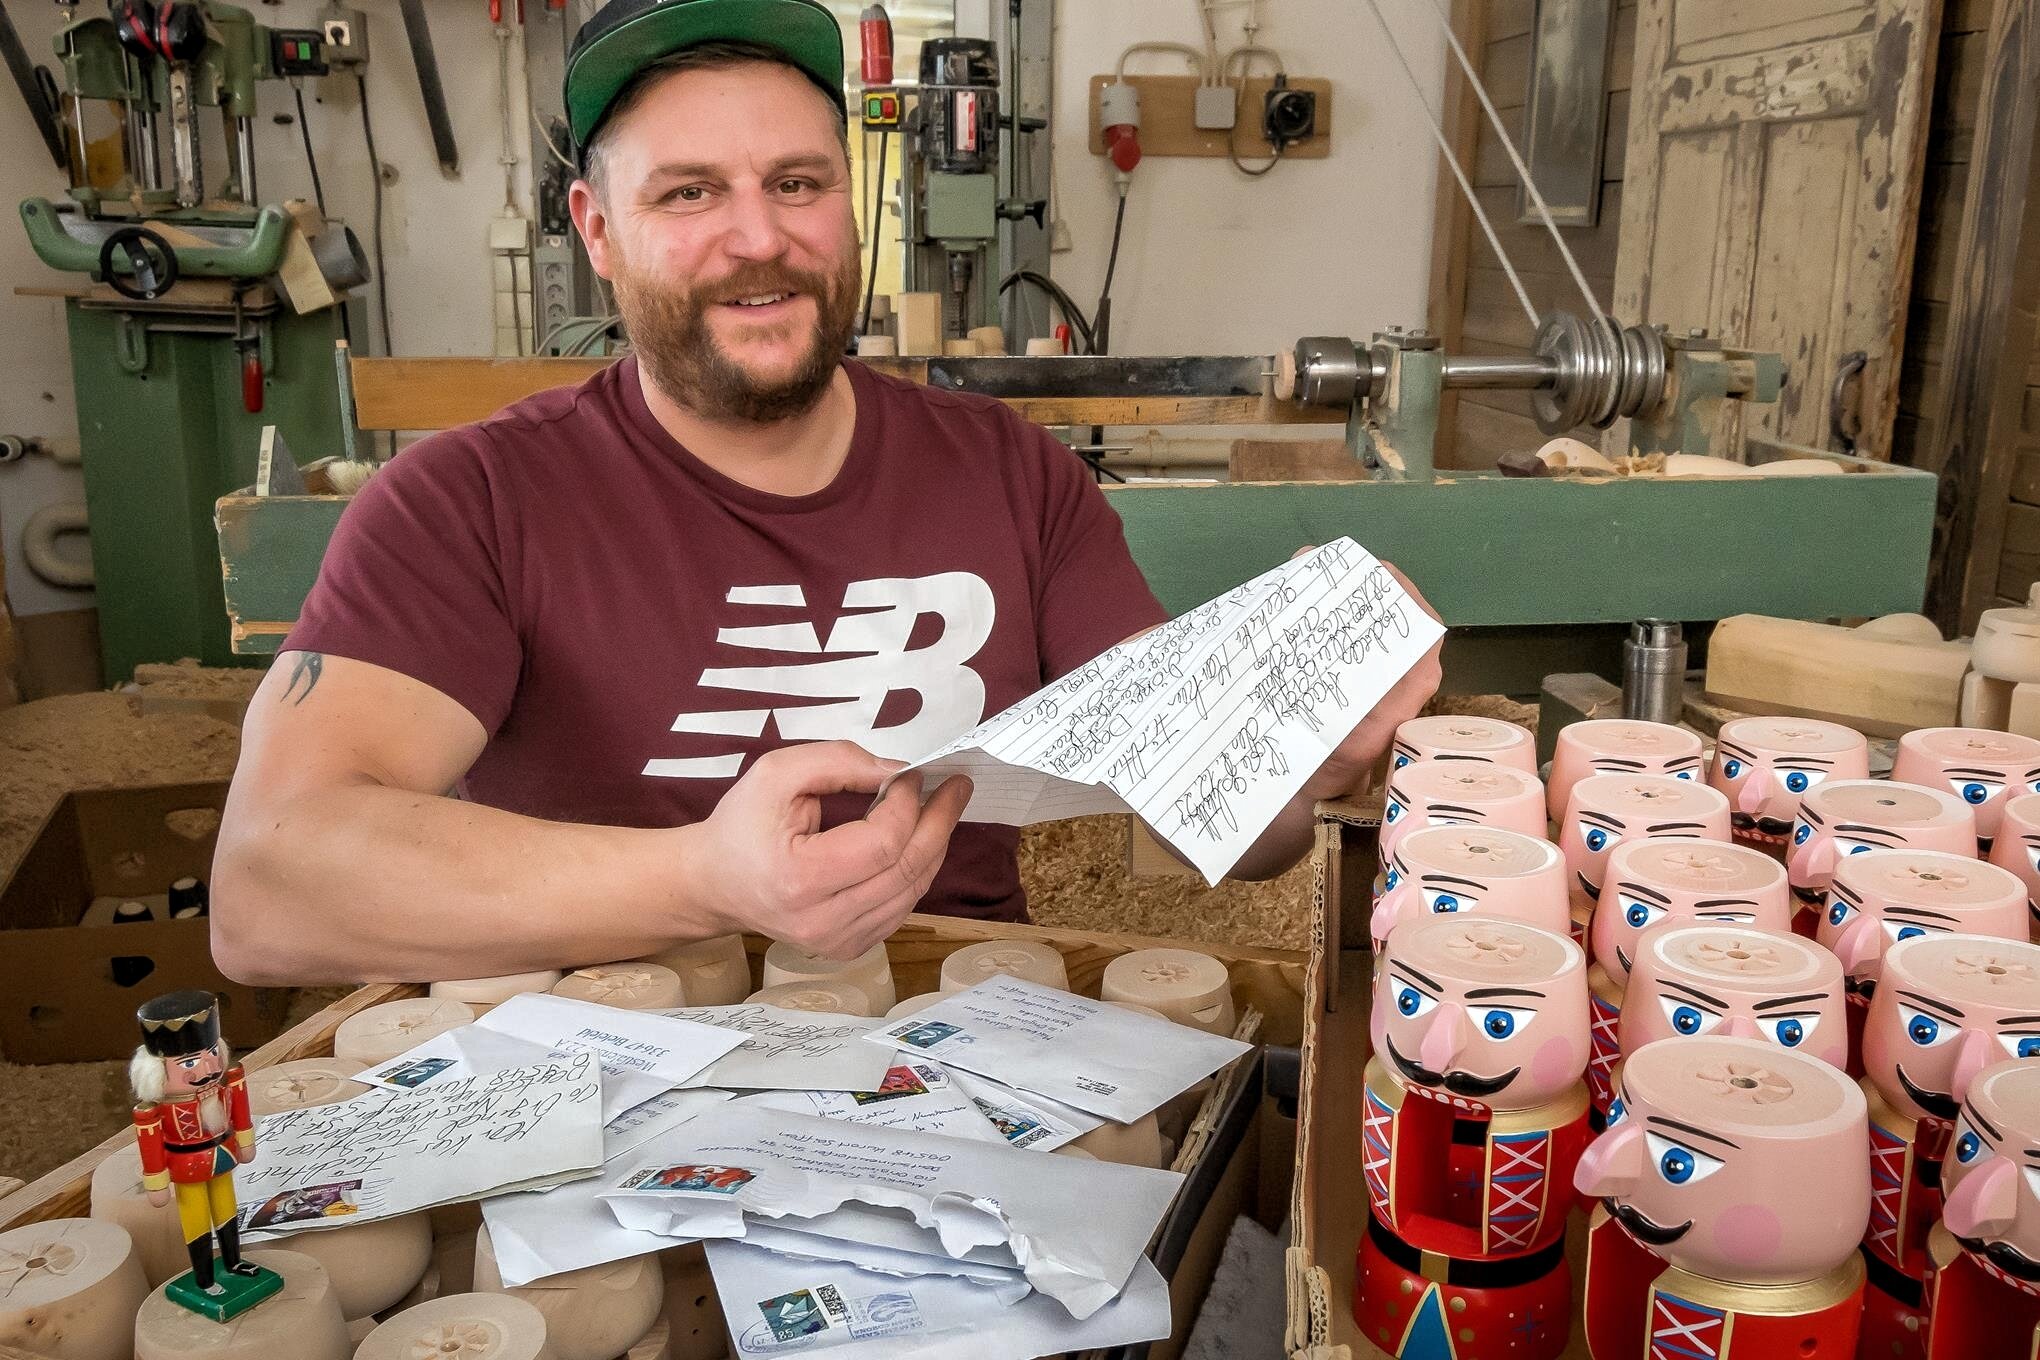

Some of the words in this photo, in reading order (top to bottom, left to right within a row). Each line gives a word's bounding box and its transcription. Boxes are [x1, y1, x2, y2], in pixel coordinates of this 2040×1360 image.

[575, 1028, 630, 1047] Bielefeld
[624, 1042, 671, 1058] 33647
[777, 1329, 795, 1341] 85
